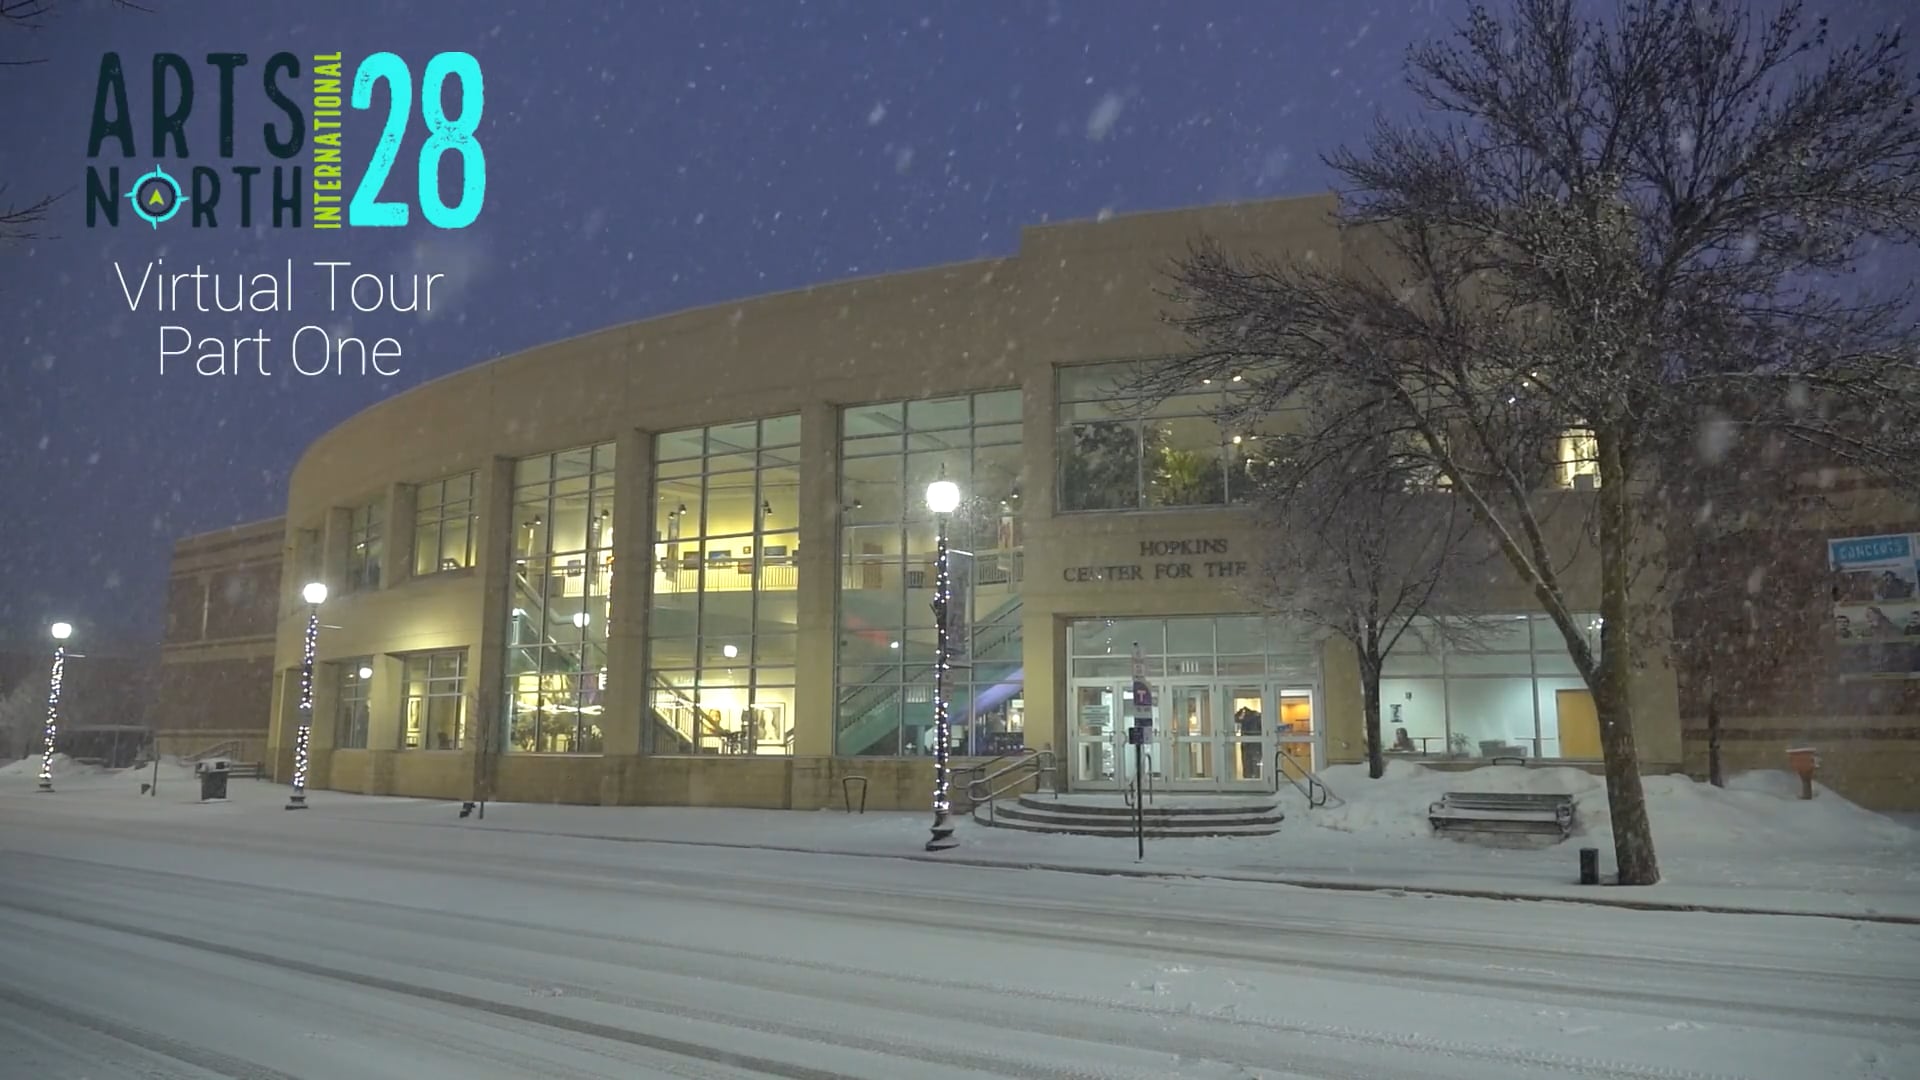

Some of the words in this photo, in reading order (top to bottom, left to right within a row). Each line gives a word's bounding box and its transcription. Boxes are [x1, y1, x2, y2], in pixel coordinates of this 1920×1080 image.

[1140, 539, 1228, 556] HOPKINS
[1155, 563, 1193, 579] FOR
[1204, 561, 1247, 577] THE
[1137, 690, 1147, 702] T
